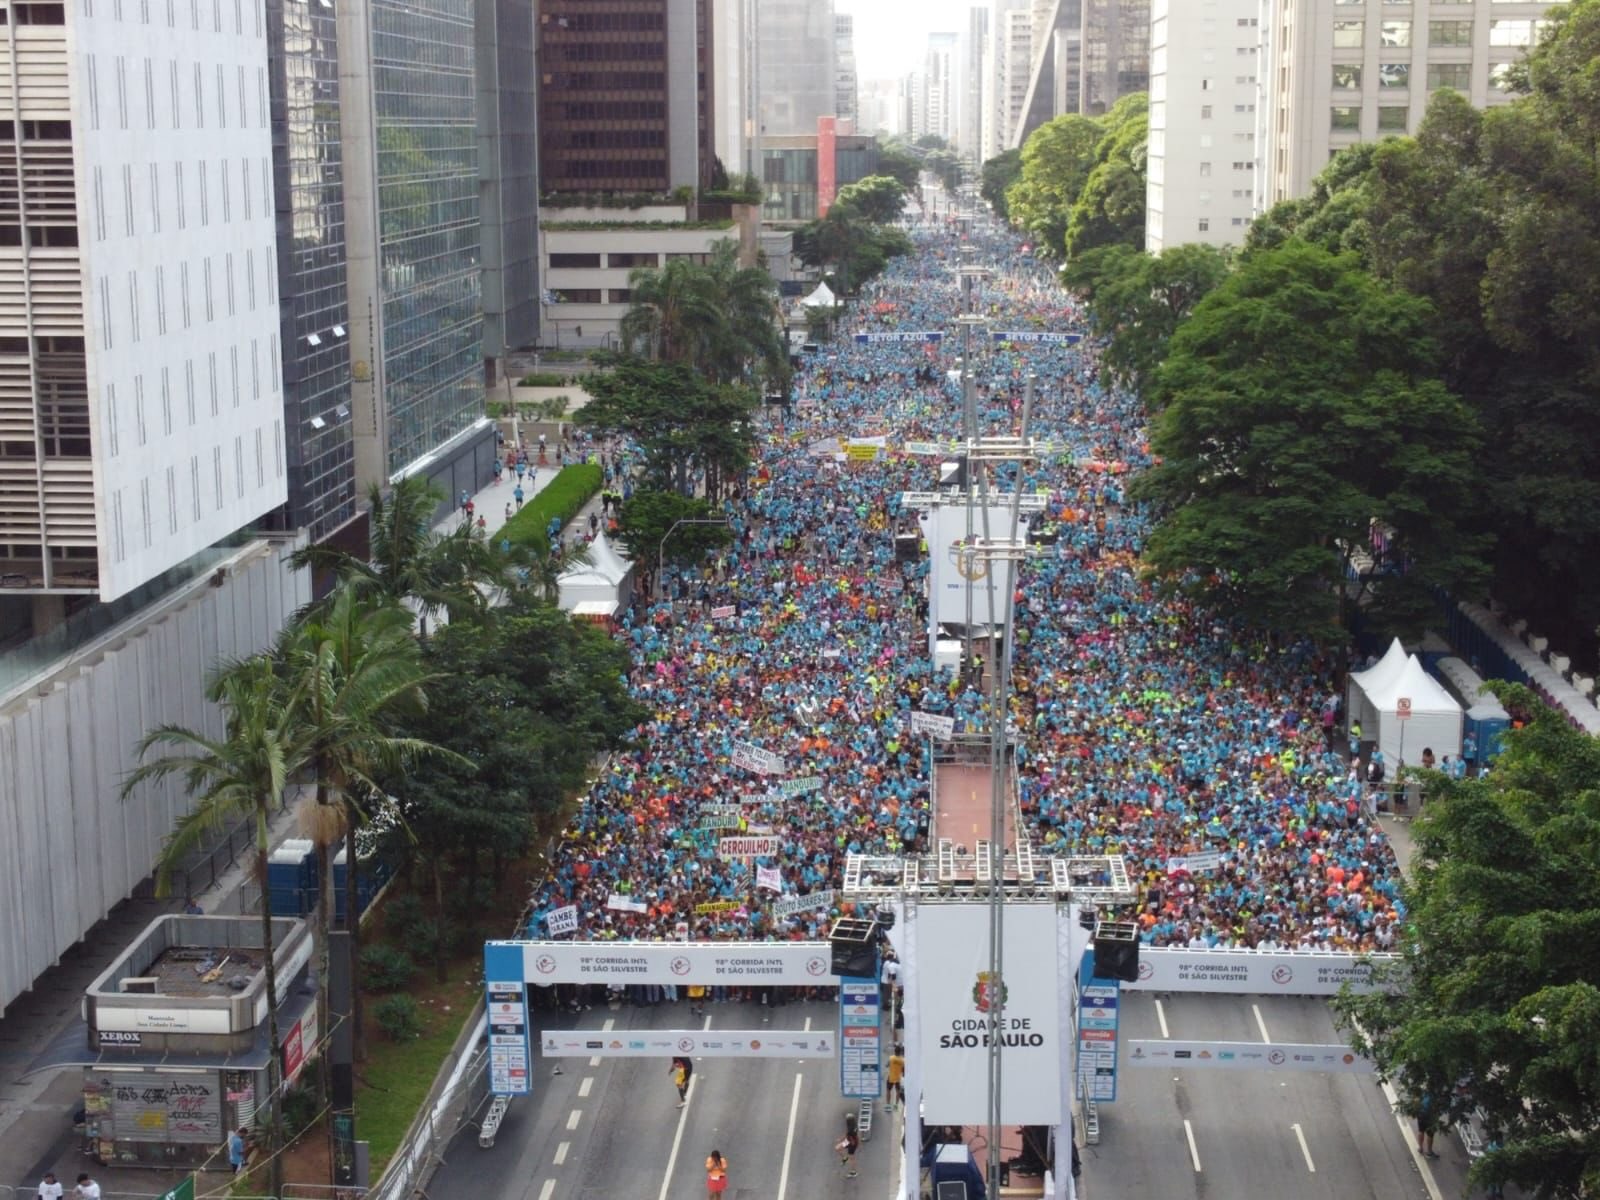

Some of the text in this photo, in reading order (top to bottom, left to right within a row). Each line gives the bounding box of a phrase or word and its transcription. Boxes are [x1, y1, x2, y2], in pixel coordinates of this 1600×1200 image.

[867, 333, 929, 342] SETOR AZUL
[1005, 333, 1068, 342] SETOR AZUL
[721, 839, 769, 854] CERQUILHO
[774, 900, 797, 914] SOUTO
[595, 957, 629, 965] CORRIDA
[631, 957, 648, 965] INTL
[1194, 964, 1229, 972] CORRIDA
[1231, 965, 1248, 973] INTL
[1210, 973, 1248, 981] SILVESTRE
[1011, 1018, 1031, 1030] DE
[100, 1032, 140, 1041] XEROX
[940, 1031, 1044, 1048] SÃO PAULO
